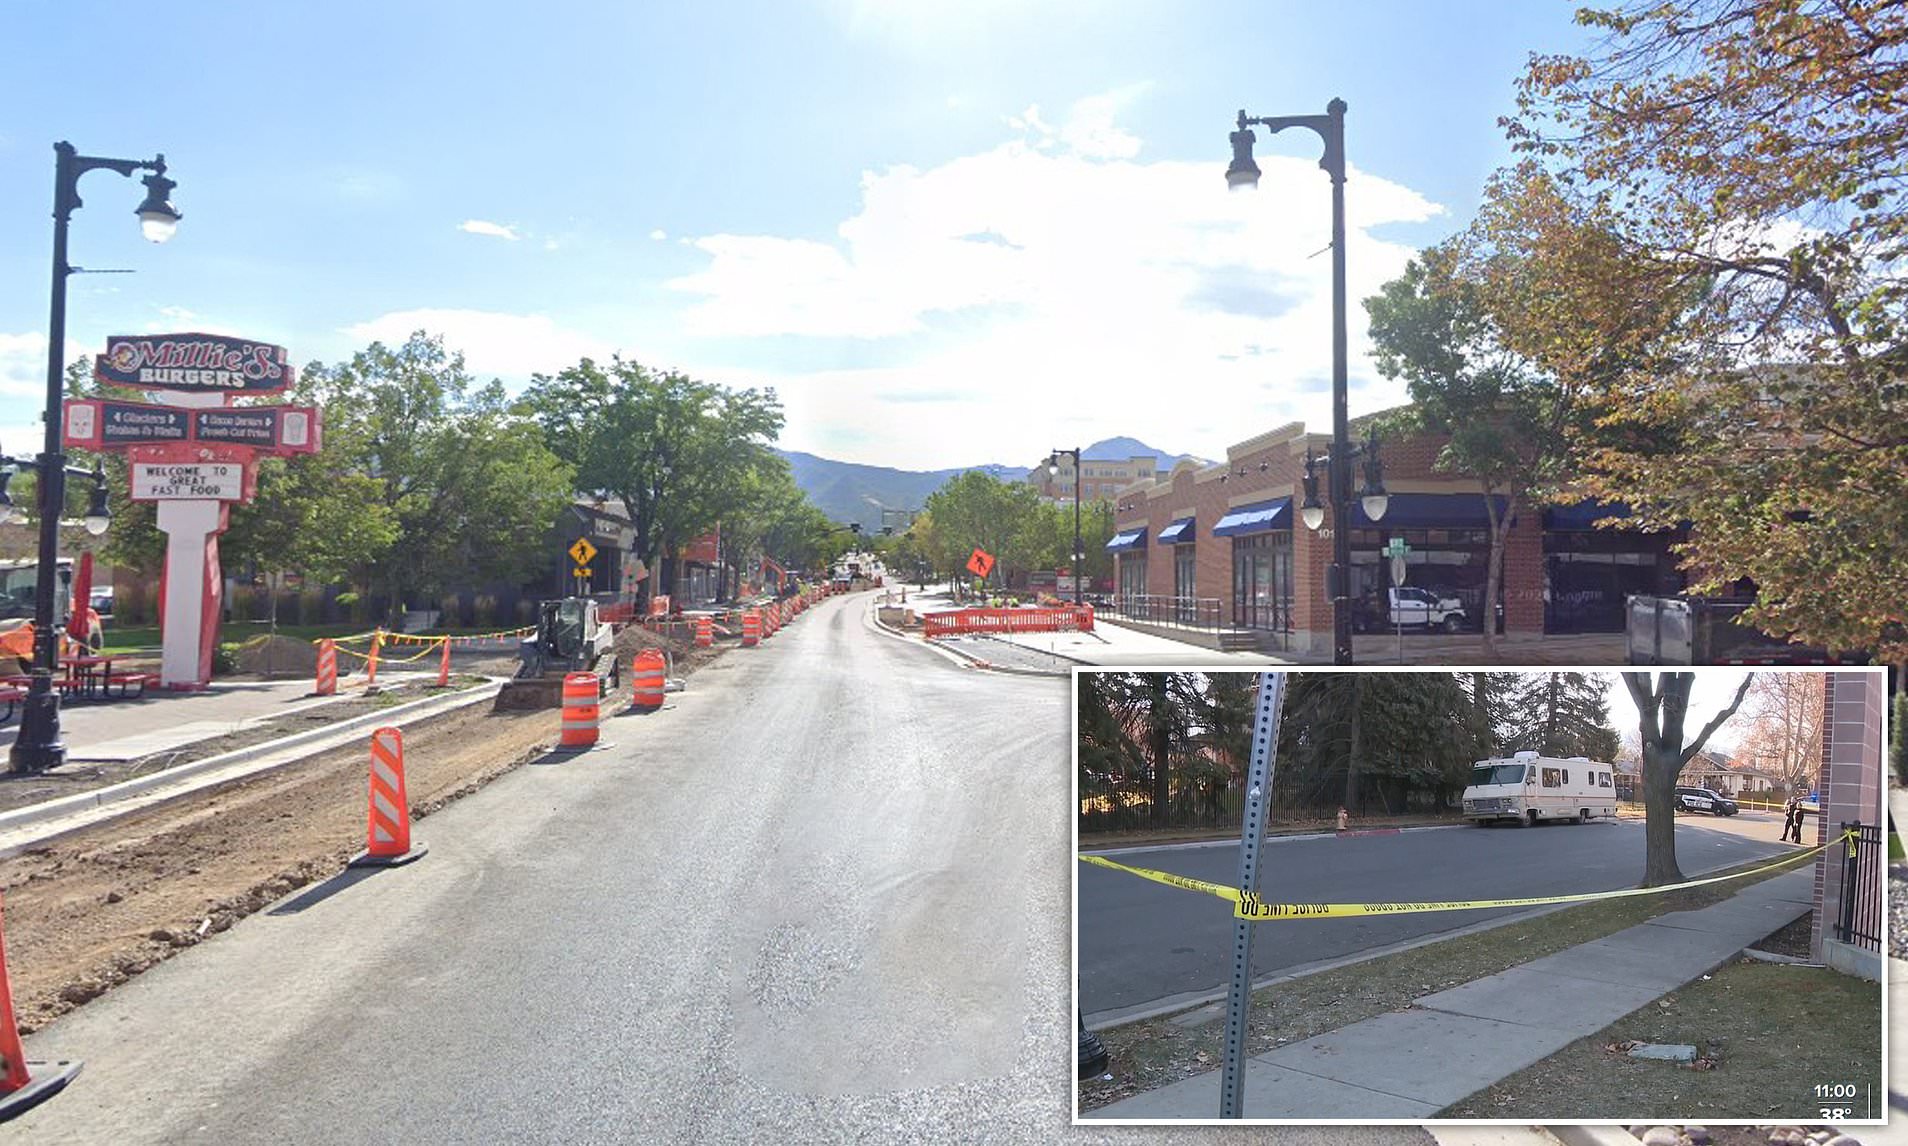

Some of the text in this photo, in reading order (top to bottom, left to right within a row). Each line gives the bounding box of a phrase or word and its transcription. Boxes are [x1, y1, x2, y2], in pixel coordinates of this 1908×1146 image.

[139, 368, 246, 388] BURGERS
[146, 466, 228, 476] WELCOME TO
[169, 476, 207, 486] GREAT
[151, 486, 221, 495] FAST FOOD
